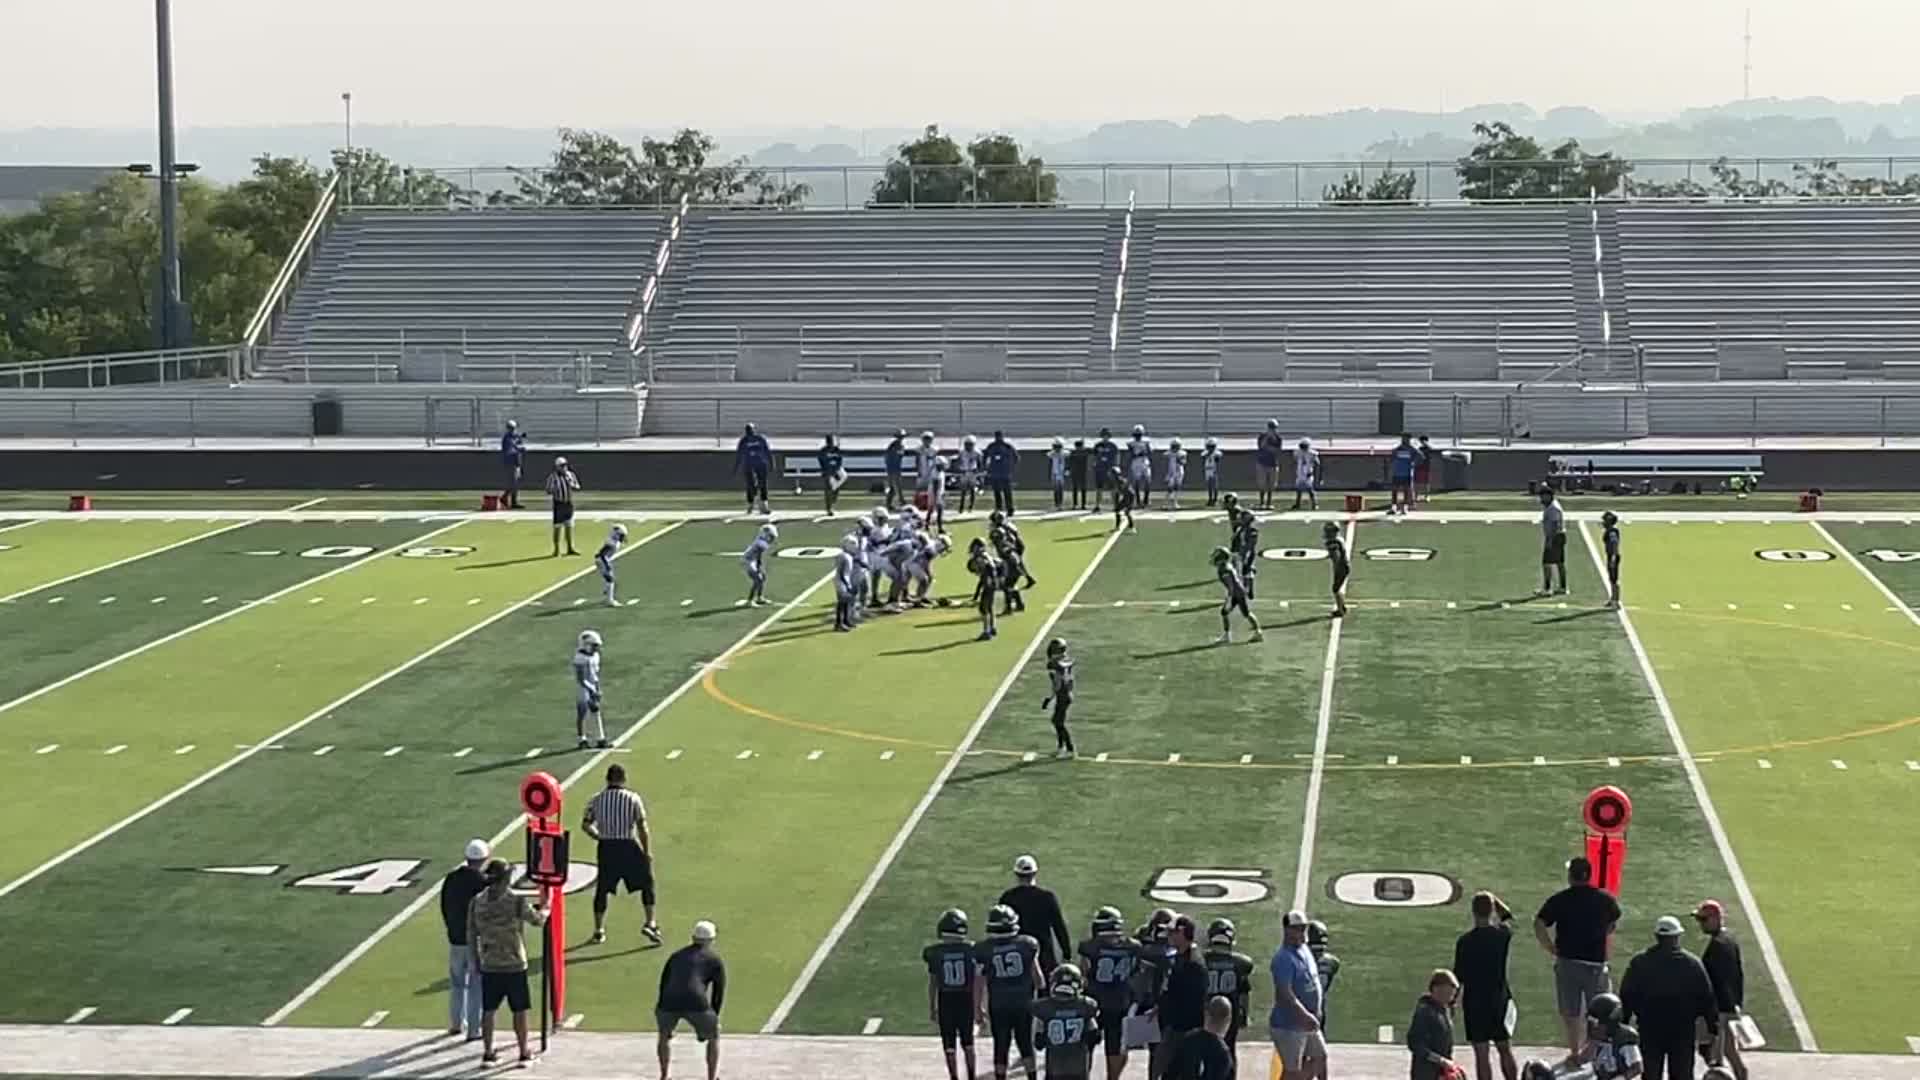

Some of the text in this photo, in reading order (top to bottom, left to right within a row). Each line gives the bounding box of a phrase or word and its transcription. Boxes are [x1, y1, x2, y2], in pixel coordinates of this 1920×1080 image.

[538, 836, 556, 873] 1
[1142, 867, 1463, 907] 50
[993, 951, 1024, 978] 13
